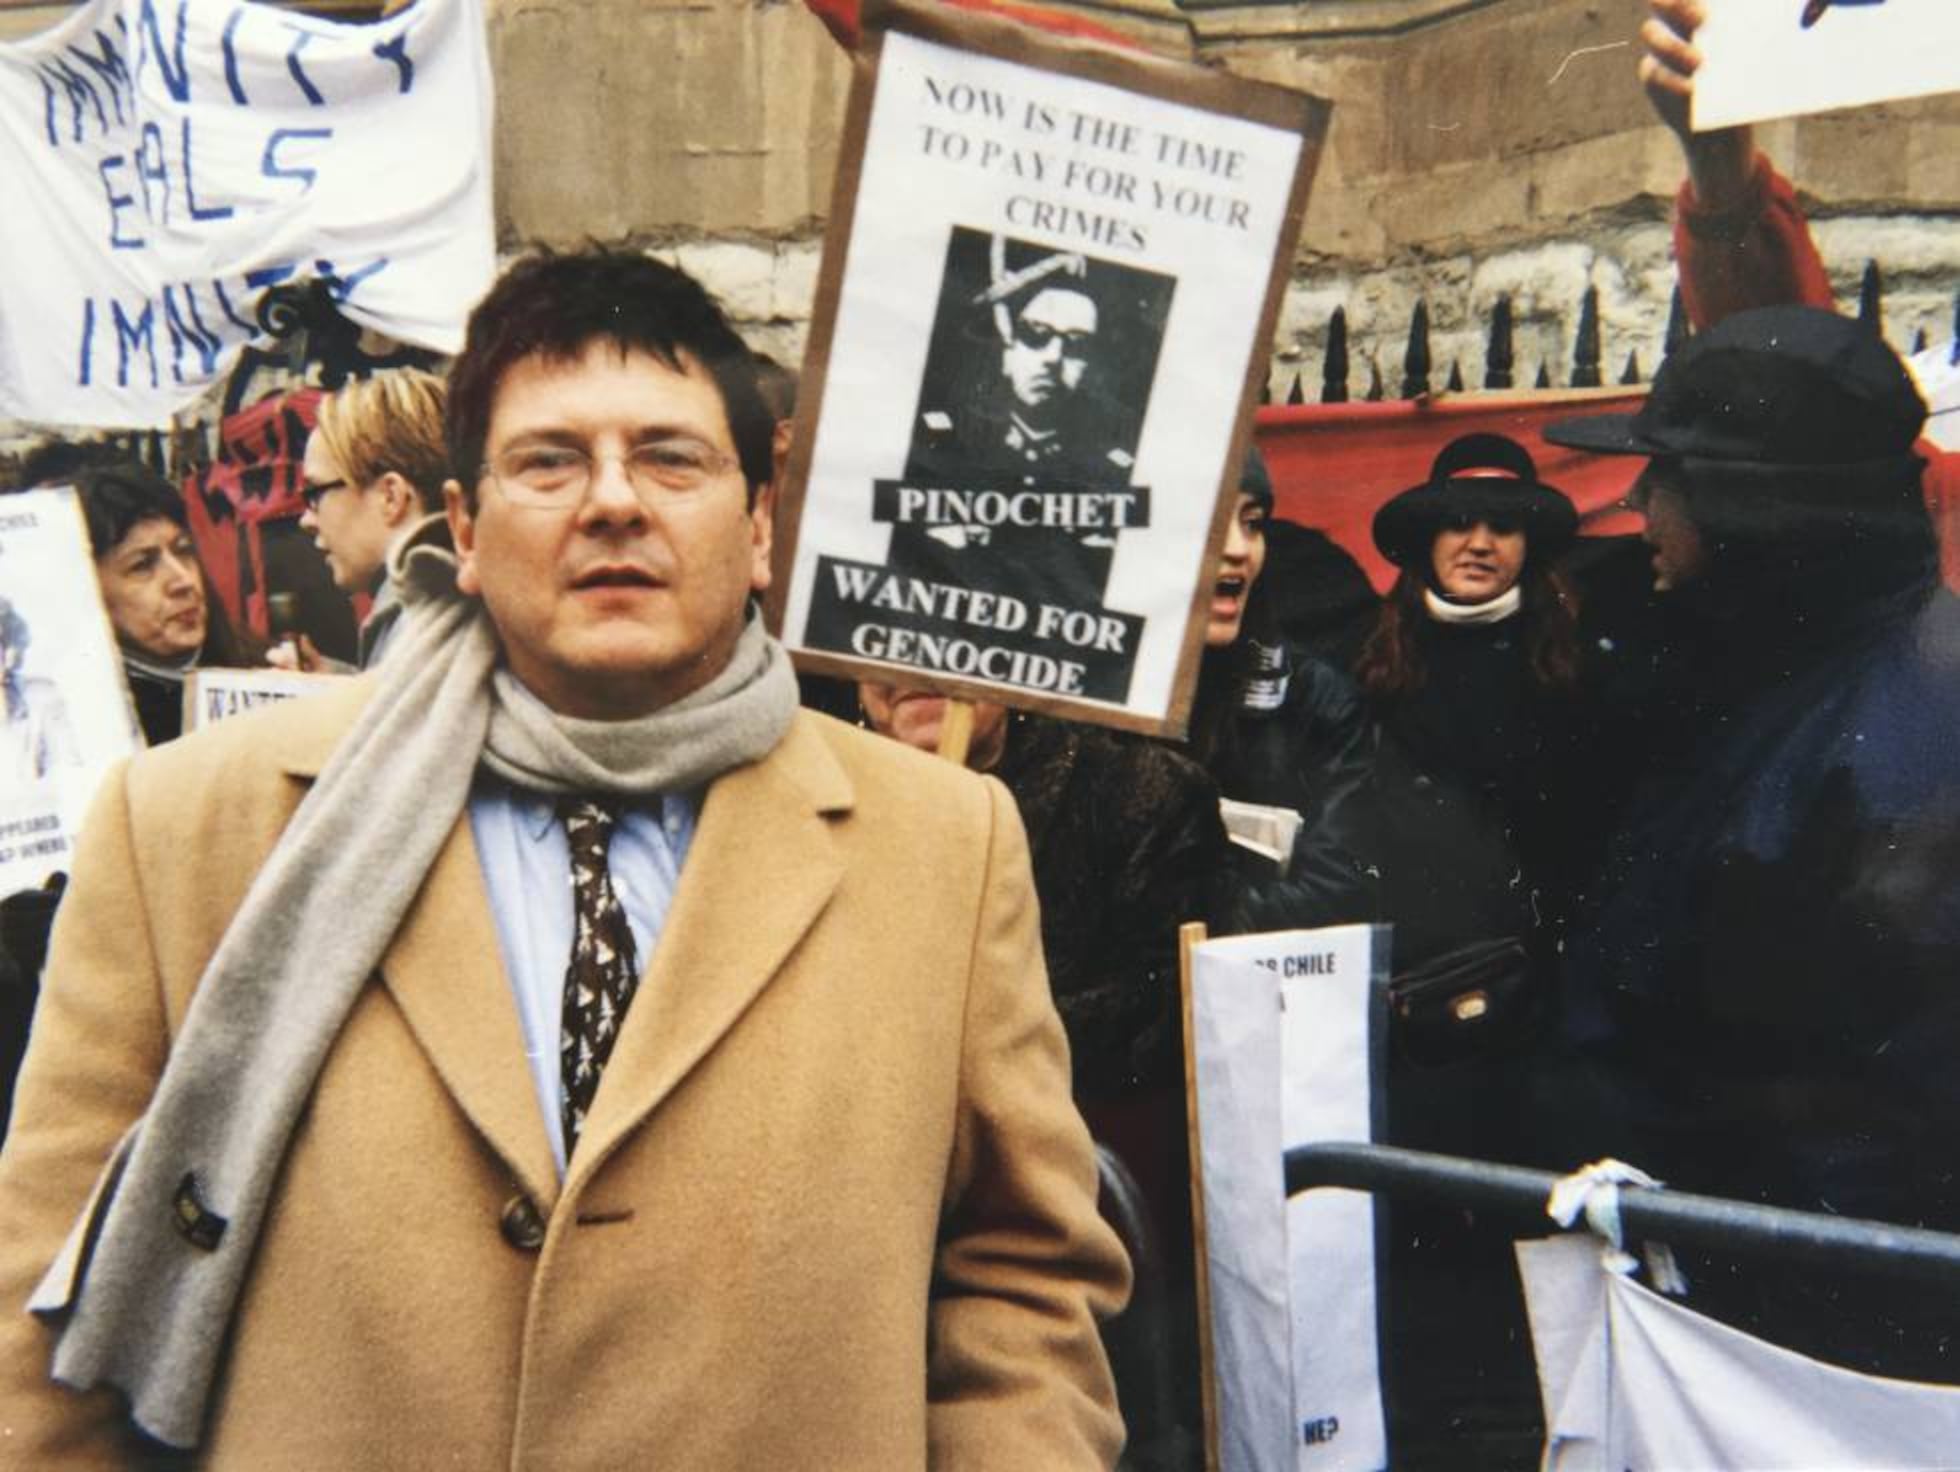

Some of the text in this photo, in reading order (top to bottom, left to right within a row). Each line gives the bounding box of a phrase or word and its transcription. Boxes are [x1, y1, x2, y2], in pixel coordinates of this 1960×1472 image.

[923, 76, 1246, 180] NOW IS THE TIME
[919, 124, 1251, 230] TO PAY FOR YOUR
[1005, 195, 1147, 251] CRIMES
[897, 488, 1136, 528] PINOCHET
[832, 564, 1128, 653] WANTED FOR
[852, 623, 1087, 696] GENOCIDE
[1283, 951, 1335, 977] CHILE
